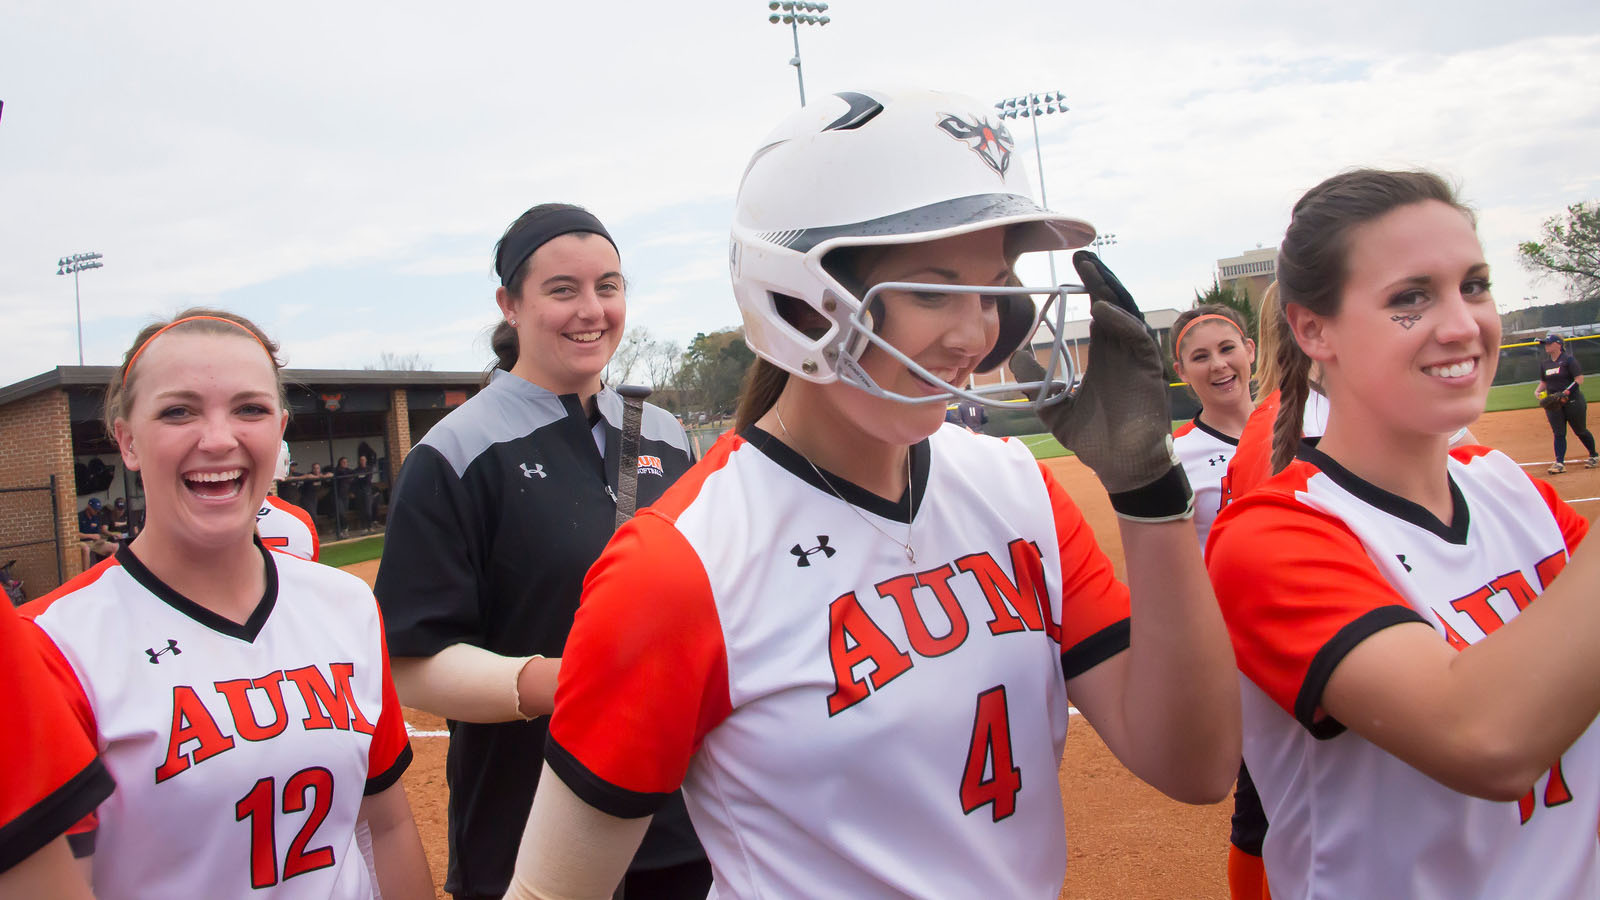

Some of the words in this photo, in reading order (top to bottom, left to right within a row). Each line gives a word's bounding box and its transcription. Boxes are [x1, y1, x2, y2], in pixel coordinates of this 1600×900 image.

[637, 455, 664, 473] UM
[968, 406, 976, 417] 11
[826, 537, 1062, 718] AUM
[155, 661, 376, 784] AUM
[958, 684, 1022, 823] 4
[235, 766, 336, 891] 12
